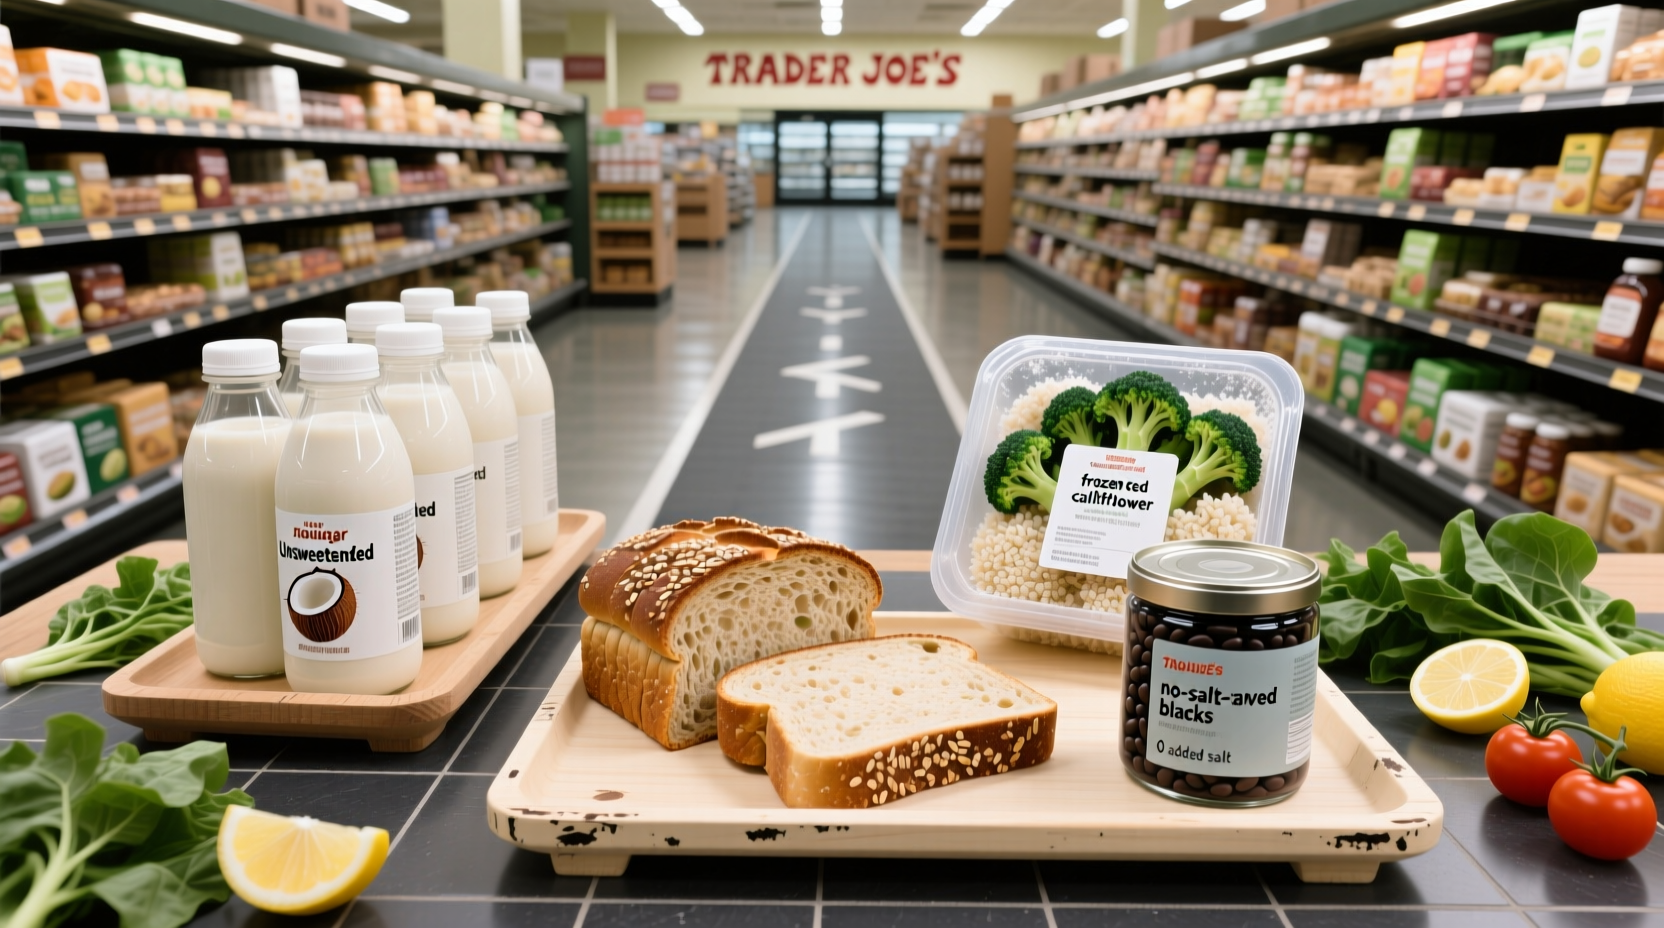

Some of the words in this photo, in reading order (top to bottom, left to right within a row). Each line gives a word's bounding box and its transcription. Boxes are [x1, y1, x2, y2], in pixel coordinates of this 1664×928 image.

[705, 53, 852, 86] TRADER
[862, 50, 962, 86] JOE'S
[1159, 697, 1214, 724] blacks
[1167, 744, 1204, 762] added
[1207, 750, 1232, 764] salt
